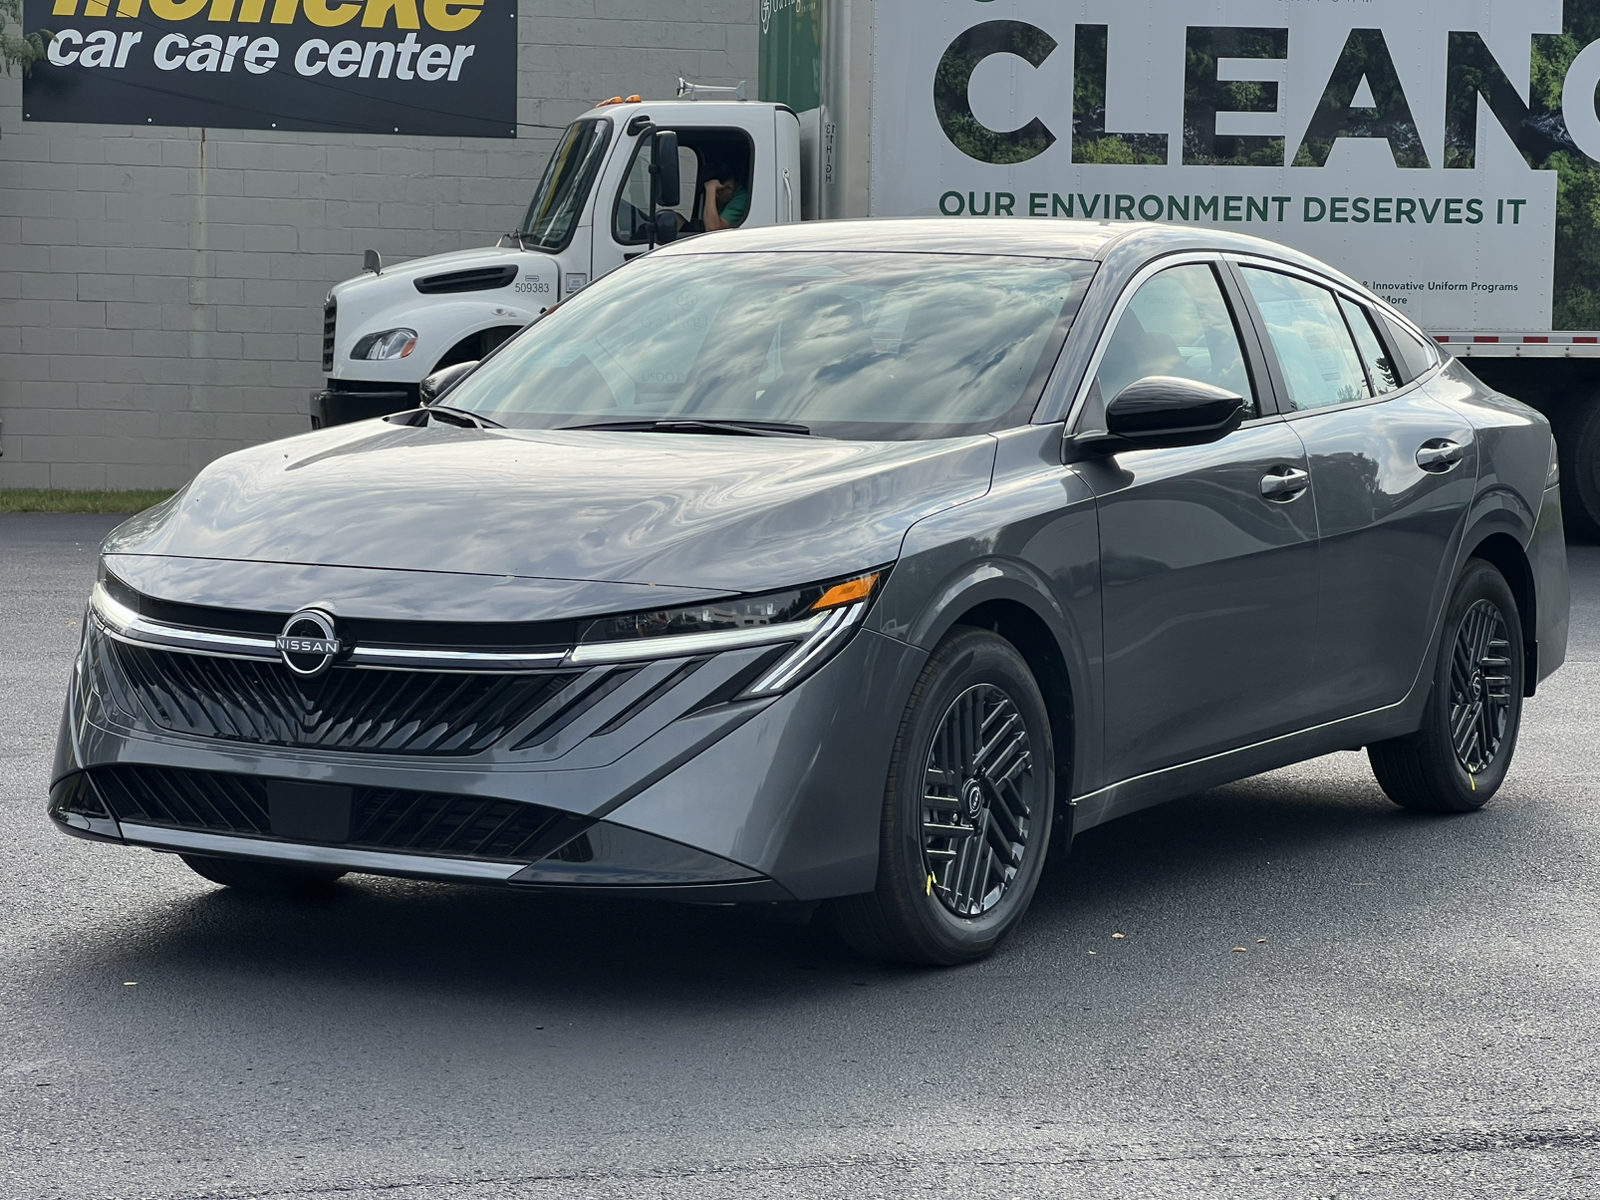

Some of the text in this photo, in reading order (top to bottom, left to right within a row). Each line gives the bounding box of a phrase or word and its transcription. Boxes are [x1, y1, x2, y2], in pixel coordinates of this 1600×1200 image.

[48, 29, 475, 82] car care center
[939, 190, 1527, 225] OUR ENVIRONMENT DESERVES IT
[514, 282, 550, 293] 509383
[1372, 280, 1425, 291] Innovative
[1427, 281, 1468, 291] Uniform
[1471, 281, 1519, 294] Programs
[641, 372, 682, 382] USDOT
[276, 638, 337, 653] NISSAN
